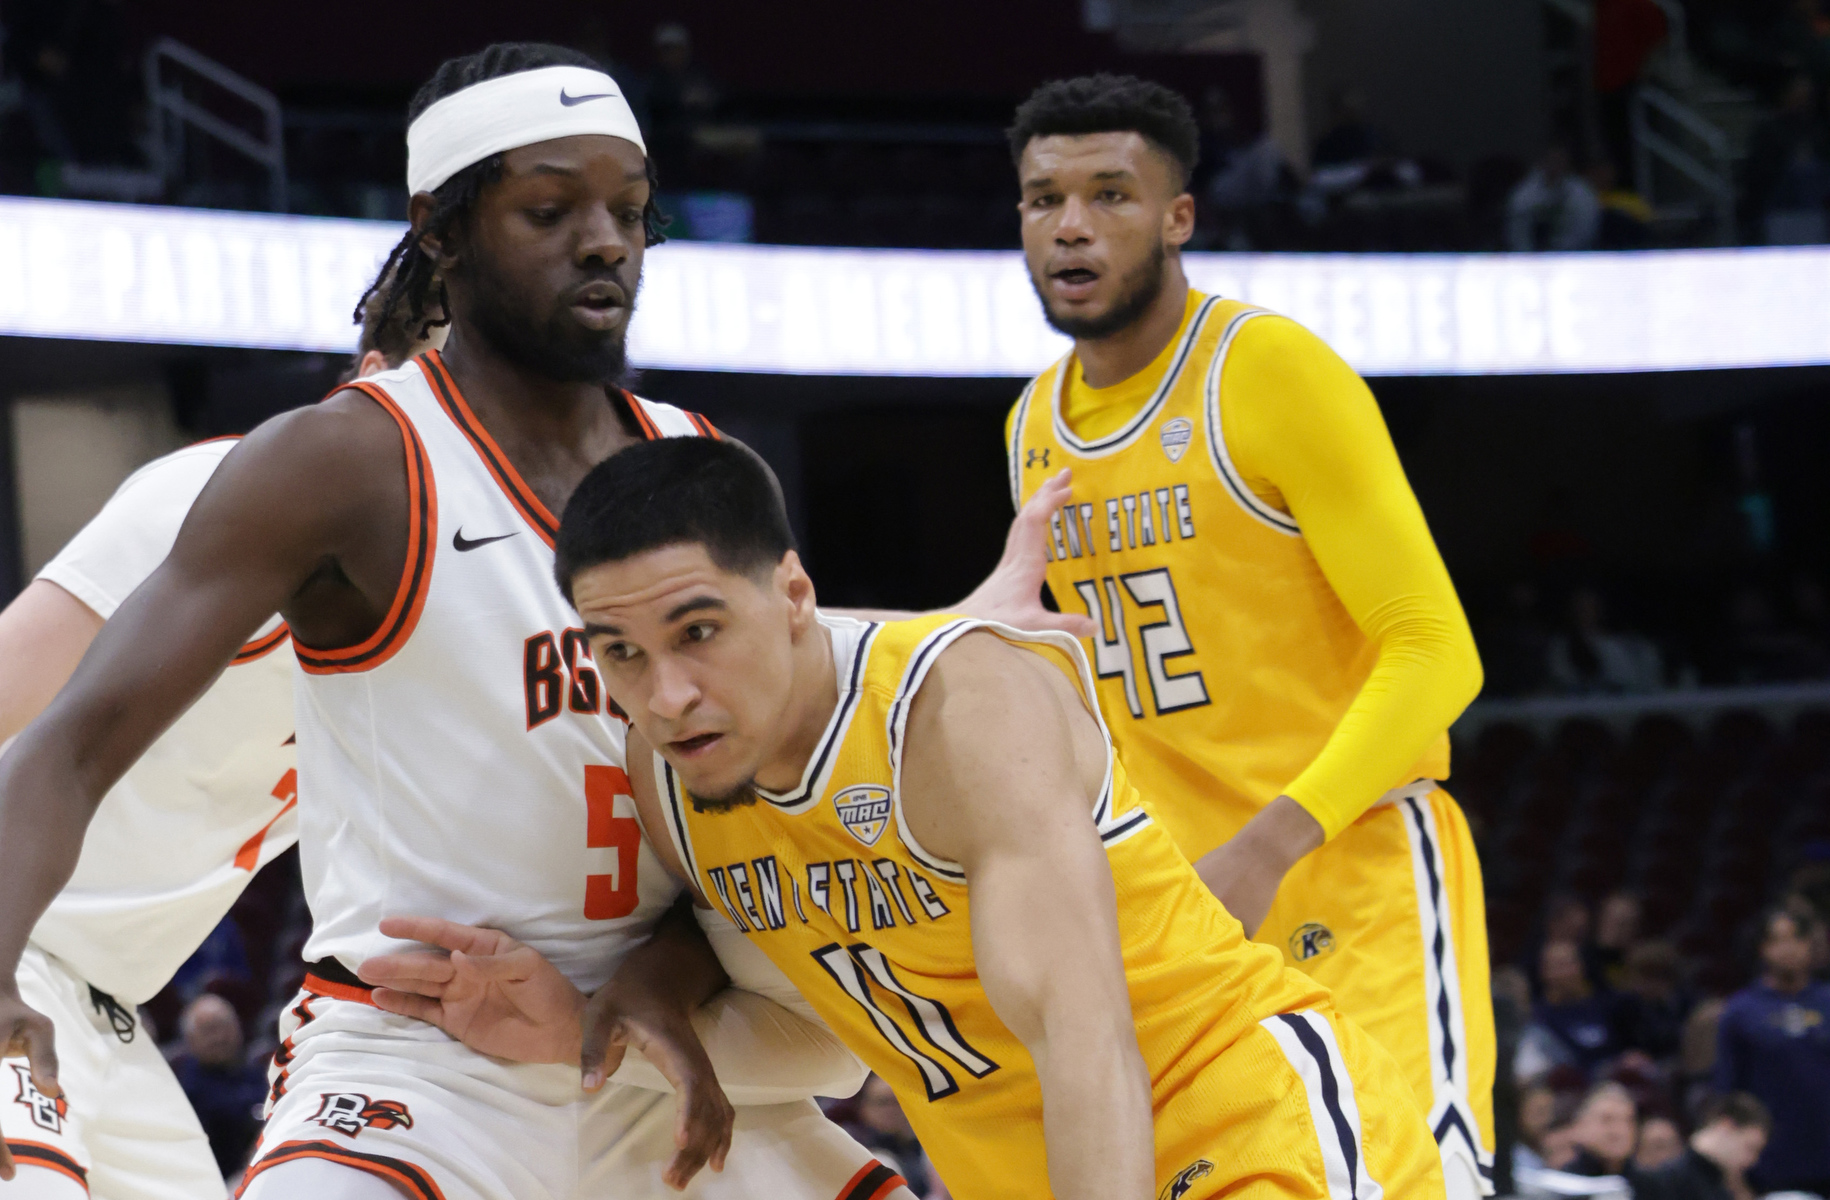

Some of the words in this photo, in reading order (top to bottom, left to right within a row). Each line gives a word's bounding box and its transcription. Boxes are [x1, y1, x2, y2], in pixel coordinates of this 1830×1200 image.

[641, 262, 1068, 362] MID-AMERIC
[1046, 502, 1096, 562] ENT
[1105, 484, 1196, 552] STATE
[523, 626, 630, 733] BG
[1073, 567, 1212, 719] 42
[583, 764, 642, 921] 5
[839, 801, 889, 823] MAC
[806, 857, 951, 934] STATE
[810, 942, 1002, 1103] 11
